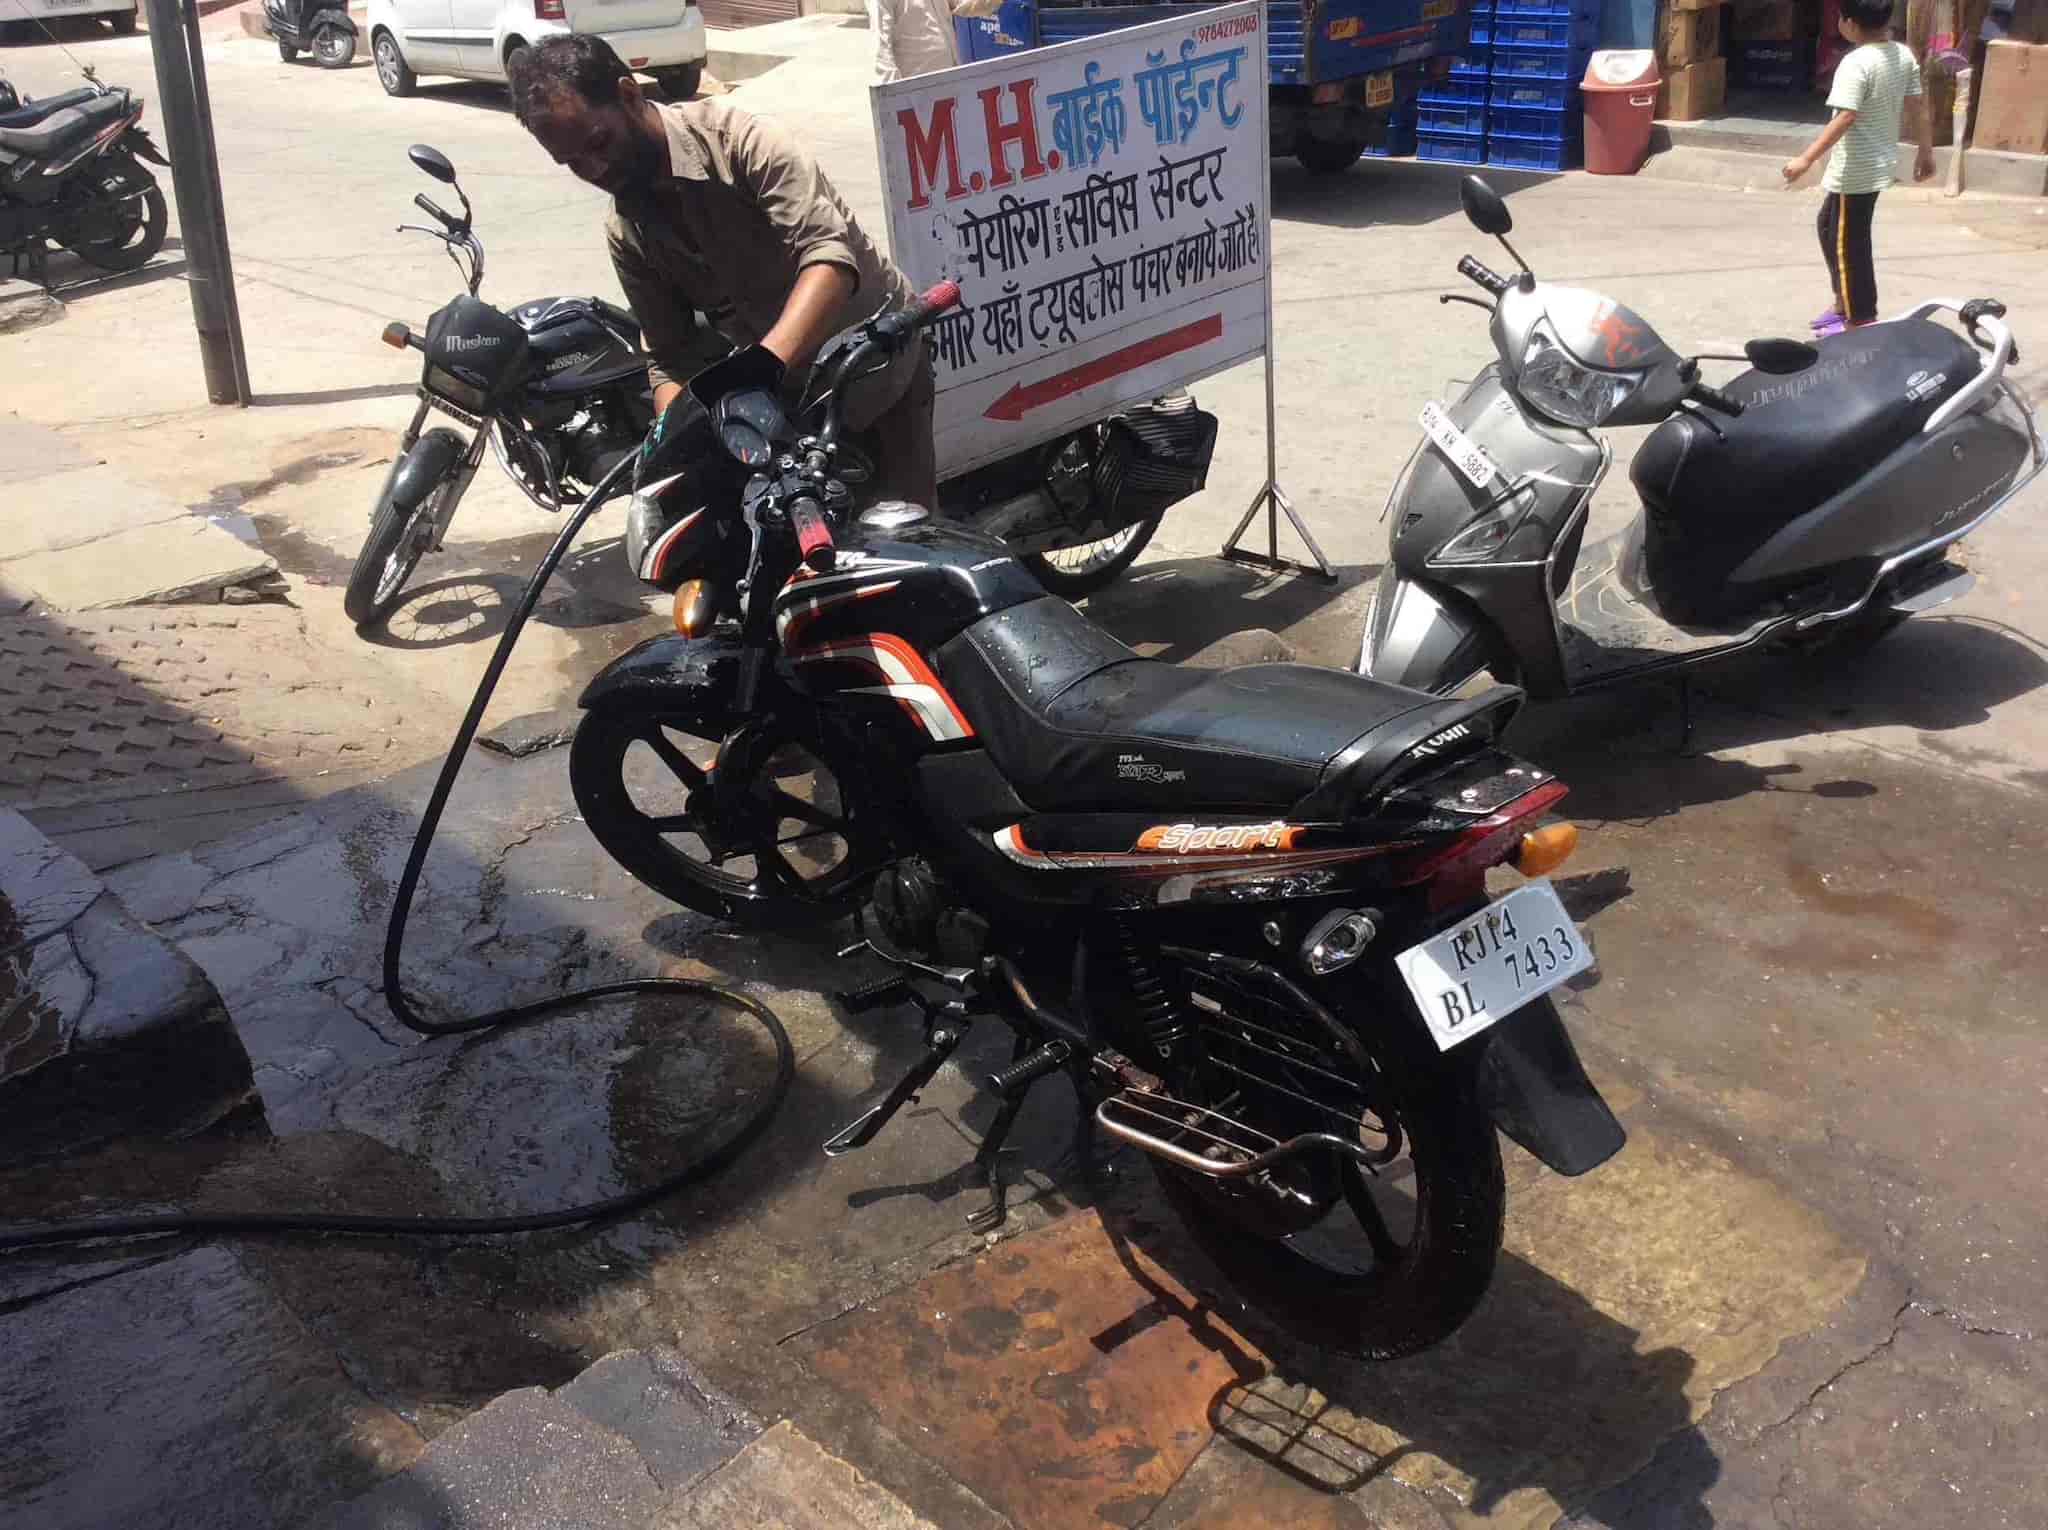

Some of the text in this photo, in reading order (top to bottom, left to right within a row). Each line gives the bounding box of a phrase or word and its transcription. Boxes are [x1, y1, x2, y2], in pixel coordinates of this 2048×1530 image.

[1440, 927, 1575, 1029] BL 7433
[1450, 906, 1518, 972] RJ14
